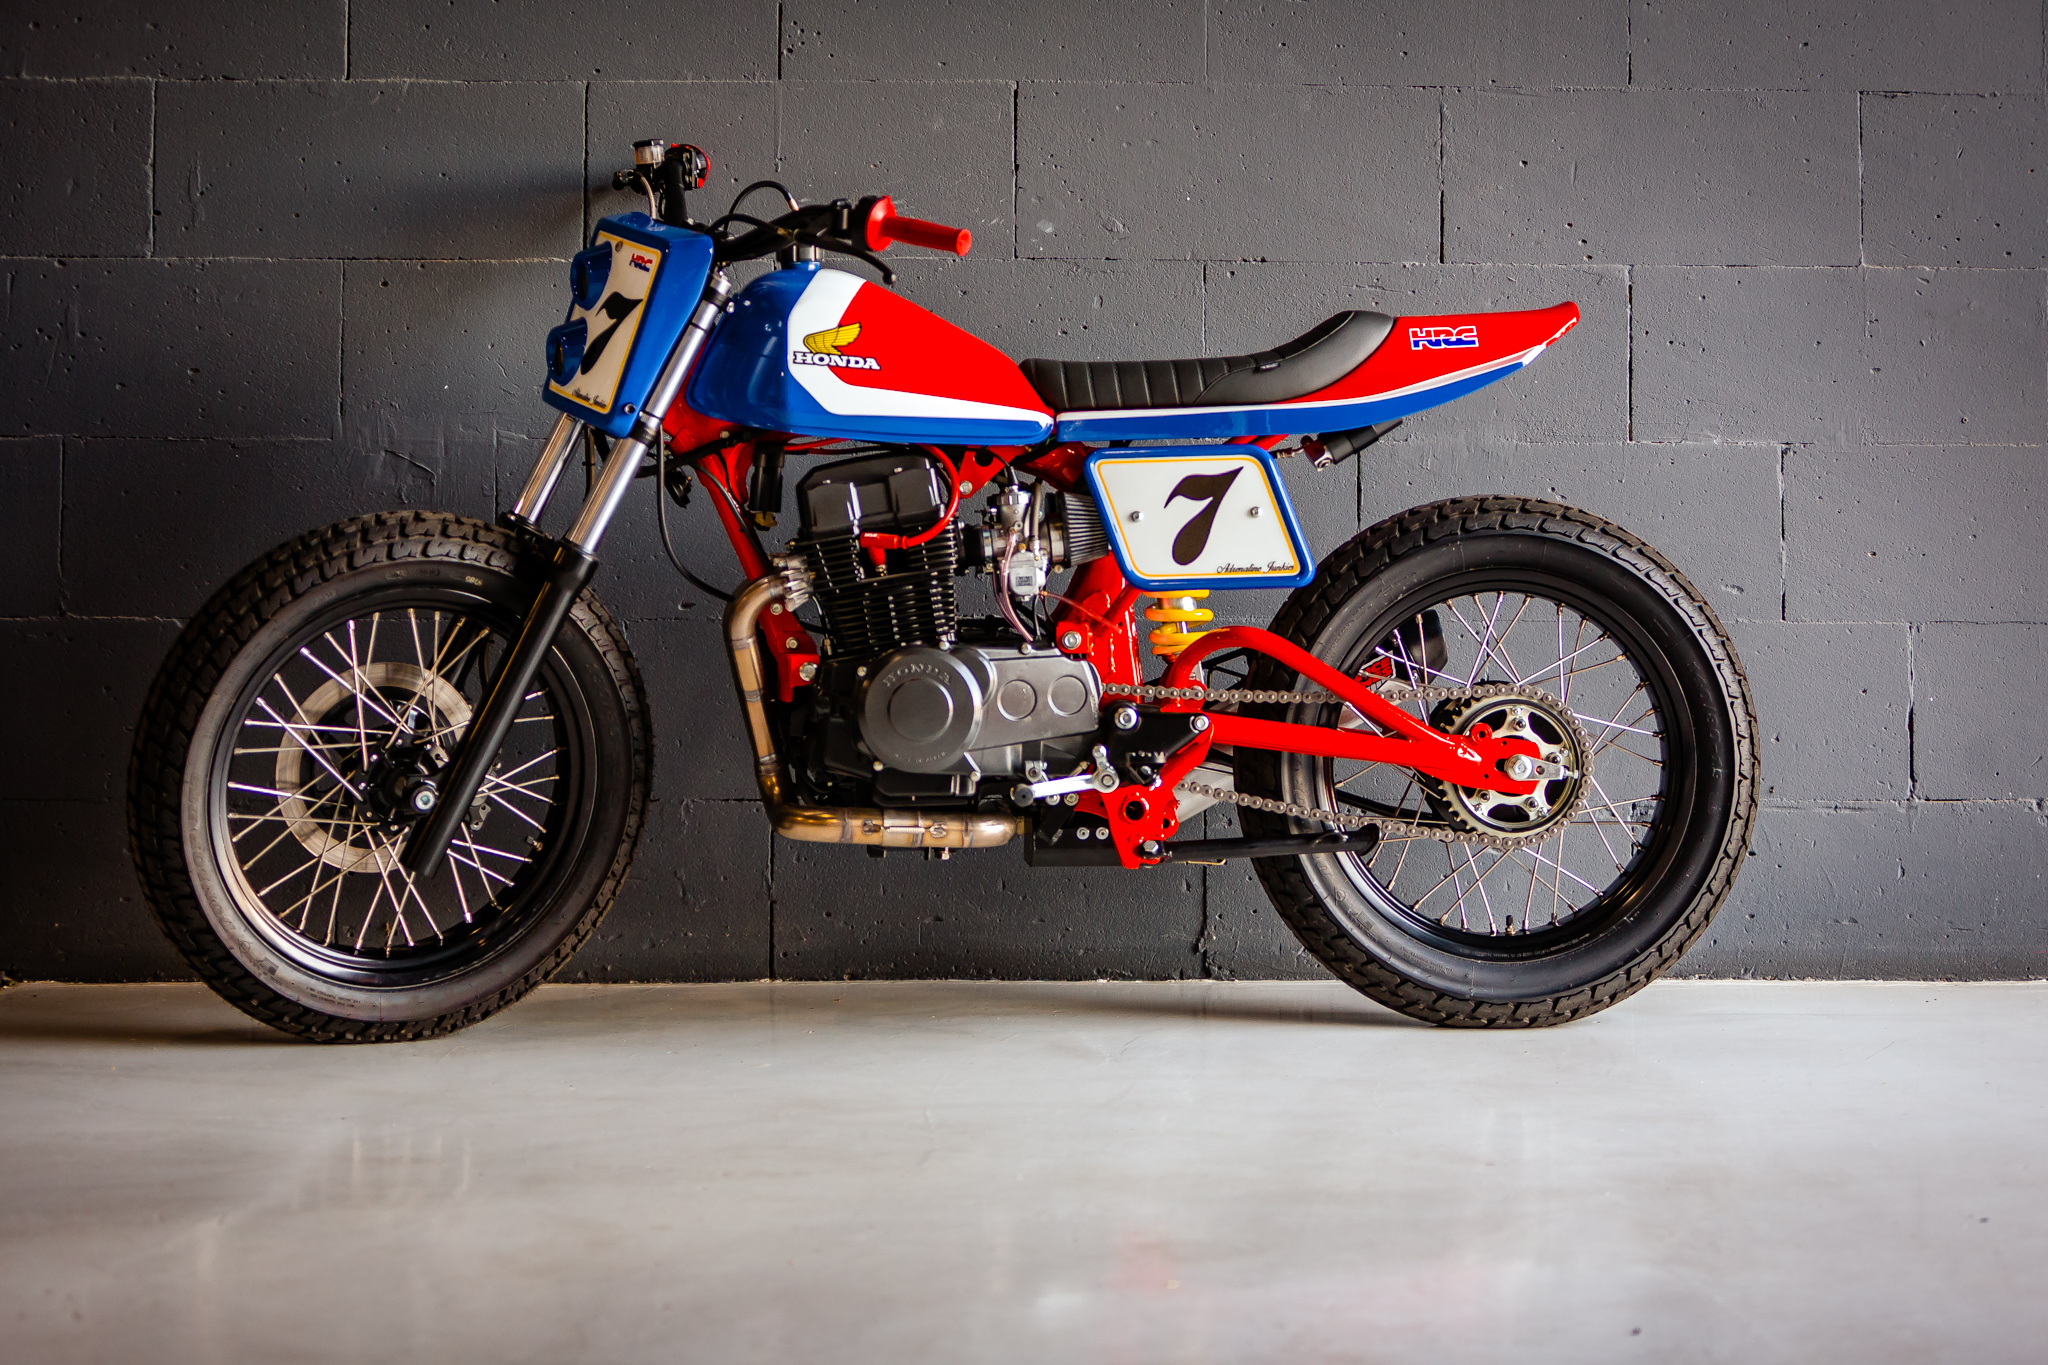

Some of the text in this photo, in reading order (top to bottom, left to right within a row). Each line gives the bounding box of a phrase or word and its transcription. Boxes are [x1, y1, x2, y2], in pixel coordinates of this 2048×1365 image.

[580, 291, 644, 376] 7
[1409, 324, 1479, 350] HRC
[793, 351, 881, 371] HONDA
[1164, 466, 1244, 566] 7
[1216, 563, 1262, 574] Adrenaline
[882, 663, 951, 687] HONDA
